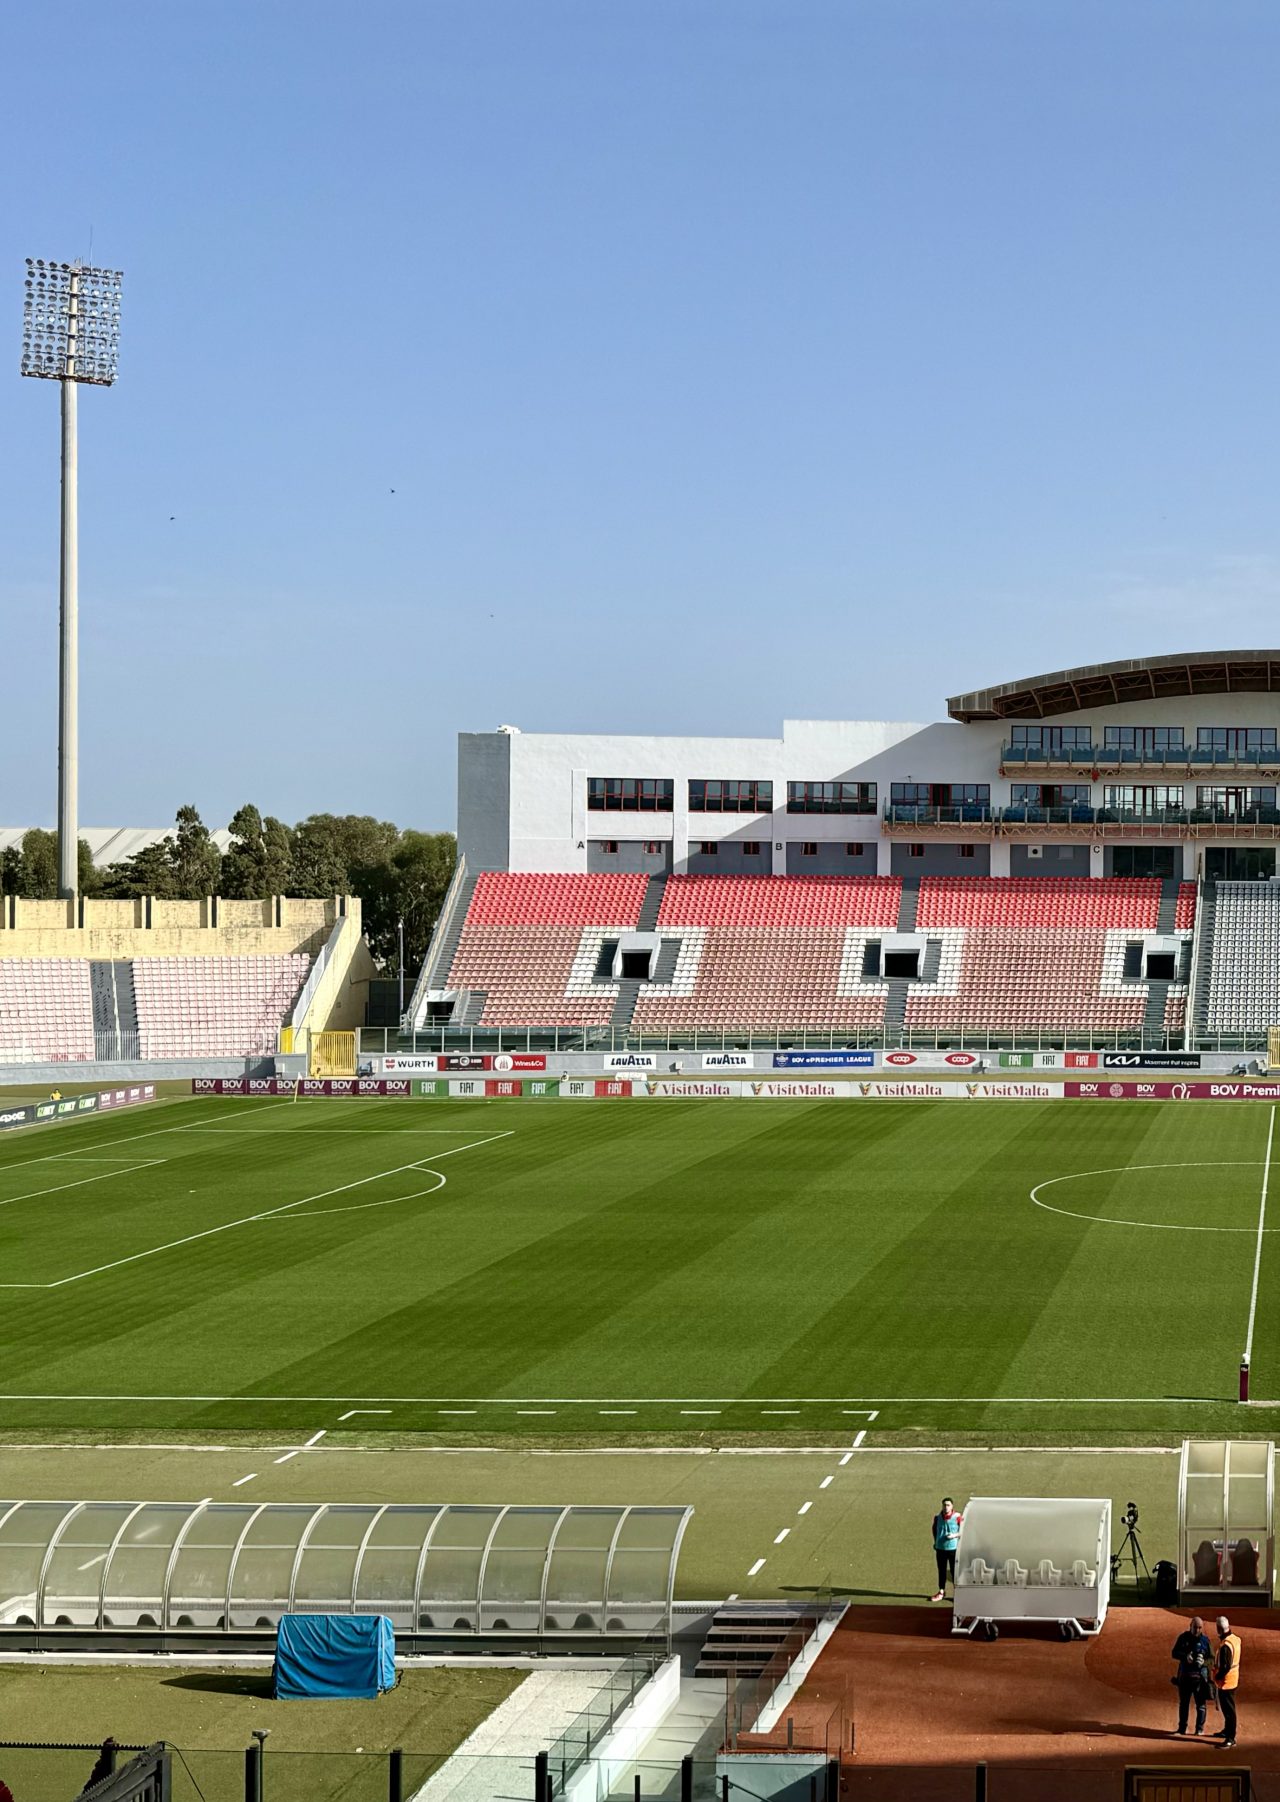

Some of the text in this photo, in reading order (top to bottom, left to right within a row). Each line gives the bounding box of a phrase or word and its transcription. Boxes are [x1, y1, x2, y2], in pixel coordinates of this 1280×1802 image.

[577, 841, 585, 849] A
[1093, 846, 1100, 854] C
[611, 1055, 652, 1066] LAVAZZA
[706, 1055, 747, 1065] LAVAZZA
[1008, 1055, 1022, 1066] FIAT
[1042, 1055, 1056, 1066] FIAT
[1076, 1055, 1088, 1066] FIAT
[196, 1080, 216, 1088] BOV
[222, 1080, 242, 1088] BOV
[250, 1080, 270, 1088] BOV
[304, 1080, 324, 1089] BOV
[332, 1080, 352, 1089] BOV
[359, 1081, 380, 1090] BOV
[386, 1081, 408, 1090] BOV
[422, 1082, 436, 1094] FIAT
[460, 1082, 474, 1094] FIAT
[498, 1082, 512, 1094] FIAT
[532, 1082, 546, 1094] FIAT
[570, 1082, 584, 1094] FIAT
[608, 1083, 622, 1094] FIAT
[662, 1084, 730, 1095] VisitMalta
[768, 1084, 834, 1095] VisitMalta
[1080, 1084, 1098, 1092] BOV
[1137, 1084, 1156, 1092] BOV
[1210, 1084, 1239, 1095] BOV
[983, 1084, 1049, 1096] VisitMalta
